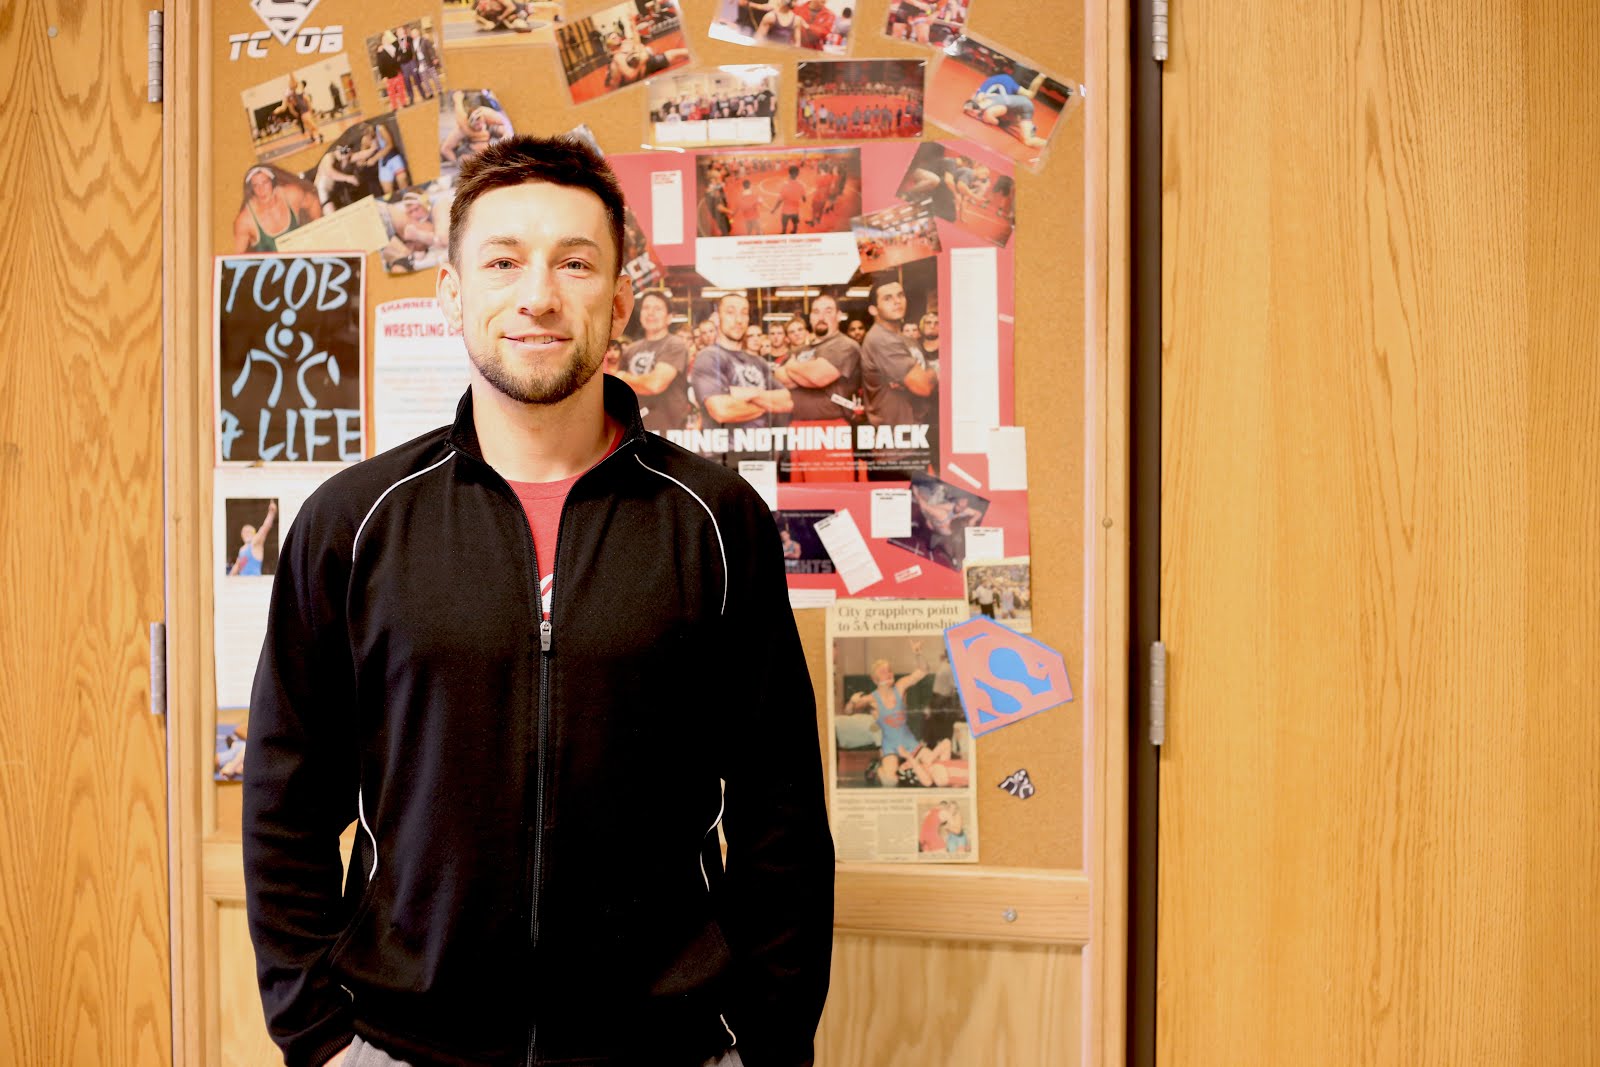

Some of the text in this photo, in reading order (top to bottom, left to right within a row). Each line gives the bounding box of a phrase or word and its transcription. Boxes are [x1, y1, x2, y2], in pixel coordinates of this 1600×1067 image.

[224, 258, 352, 313] TCOB
[384, 323, 444, 338] WRESTLING
[258, 408, 361, 462] LIFE
[649, 424, 930, 453] DING NOTHING BACK
[838, 604, 959, 620] City grapplers point
[838, 618, 960, 634] to 5A championshi
